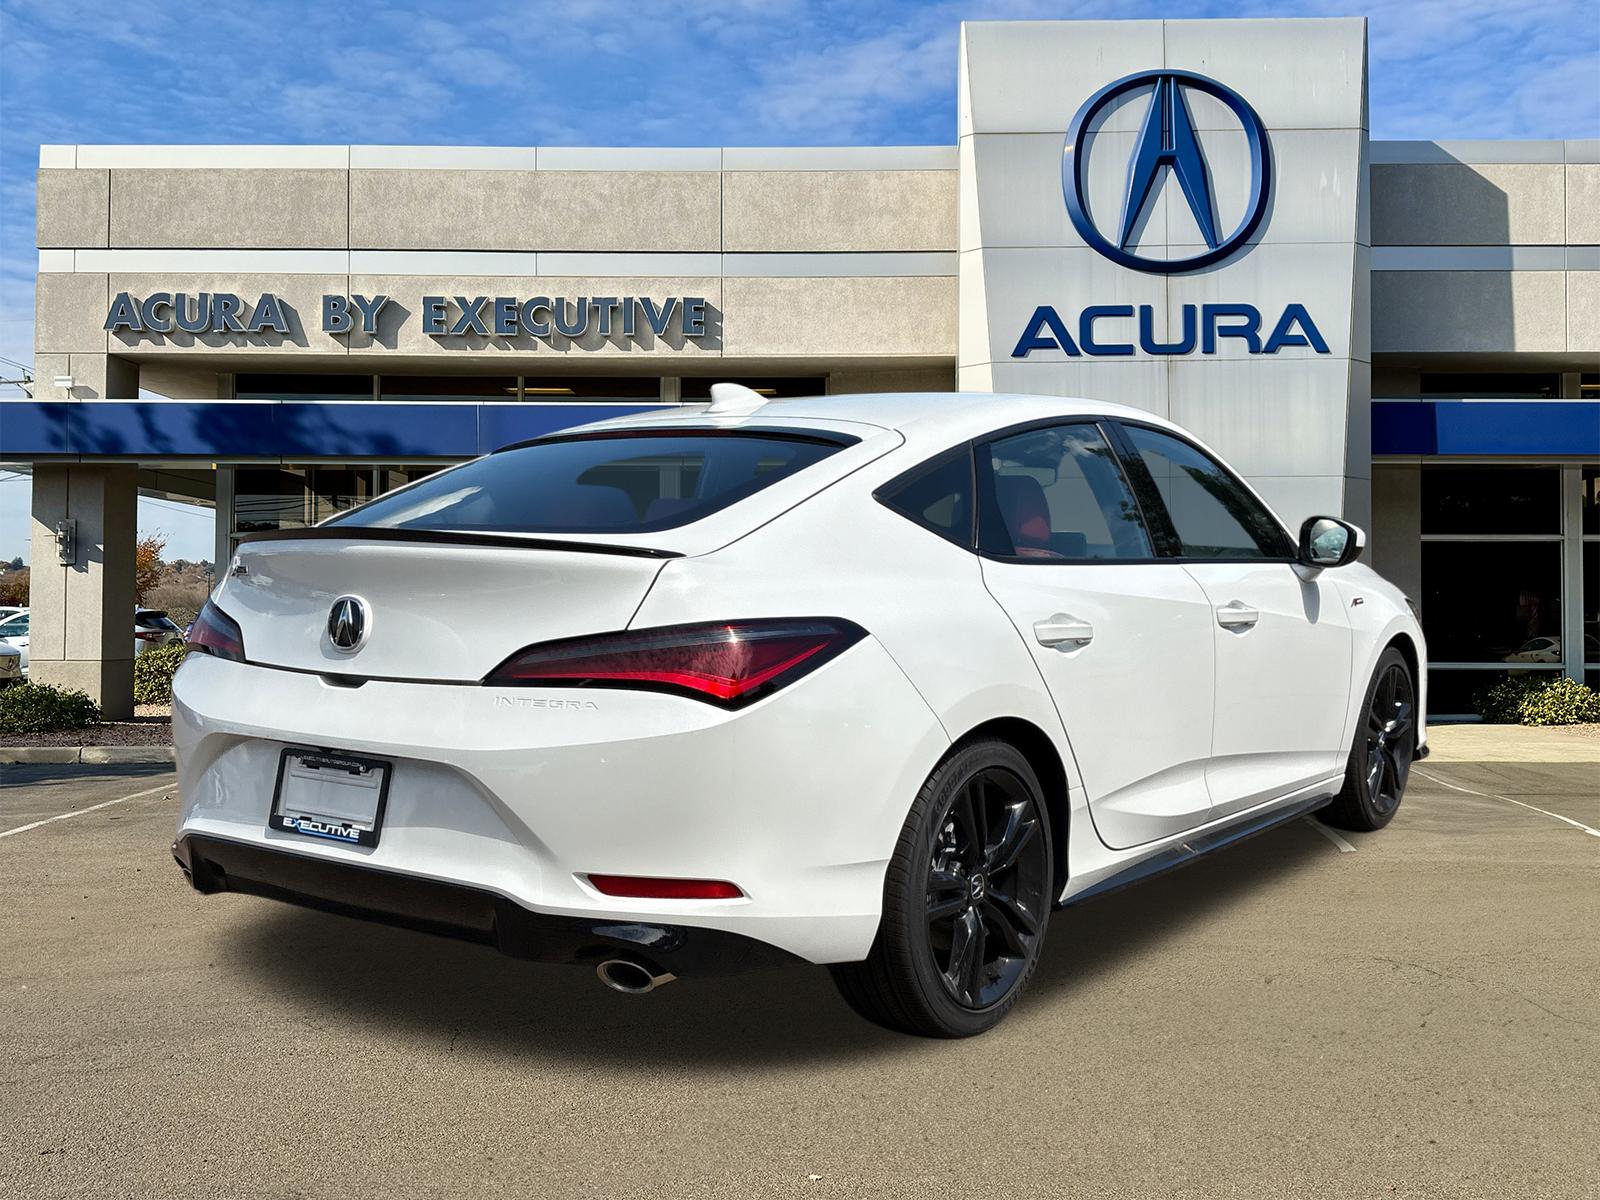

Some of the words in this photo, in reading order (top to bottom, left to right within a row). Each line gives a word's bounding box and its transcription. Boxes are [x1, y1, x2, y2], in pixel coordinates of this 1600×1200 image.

[103, 292, 289, 334] ACURA
[322, 294, 390, 334] BY
[421, 296, 706, 337] EXECUTIVE
[1011, 303, 1331, 357] ACURA
[495, 696, 599, 710] INTEGRA
[282, 817, 361, 839] EXECUTIVE
